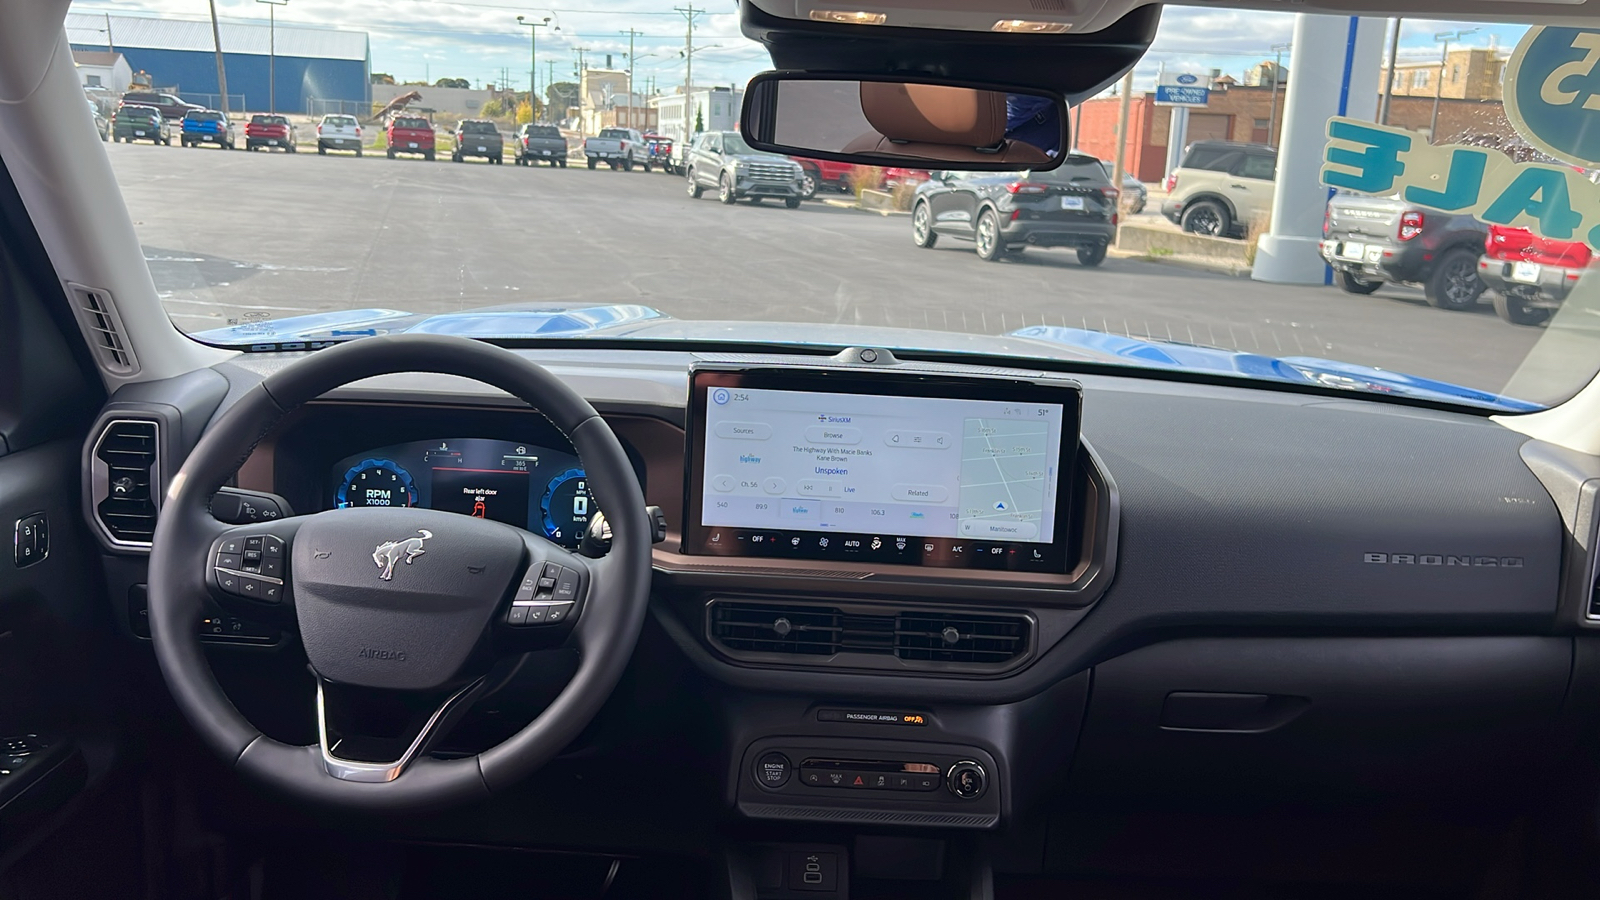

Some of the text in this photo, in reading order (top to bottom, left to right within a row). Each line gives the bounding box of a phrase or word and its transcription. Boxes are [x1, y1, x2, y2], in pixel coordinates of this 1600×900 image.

[734, 394, 749, 402] 2:54
[804, 446, 827, 455] Highway
[814, 467, 848, 476] Unspoken
[366, 490, 391, 499] RPM
[574, 496, 588, 515] 0
[1364, 552, 1524, 568] BRONCO
[358, 648, 406, 661] AIRBAG
